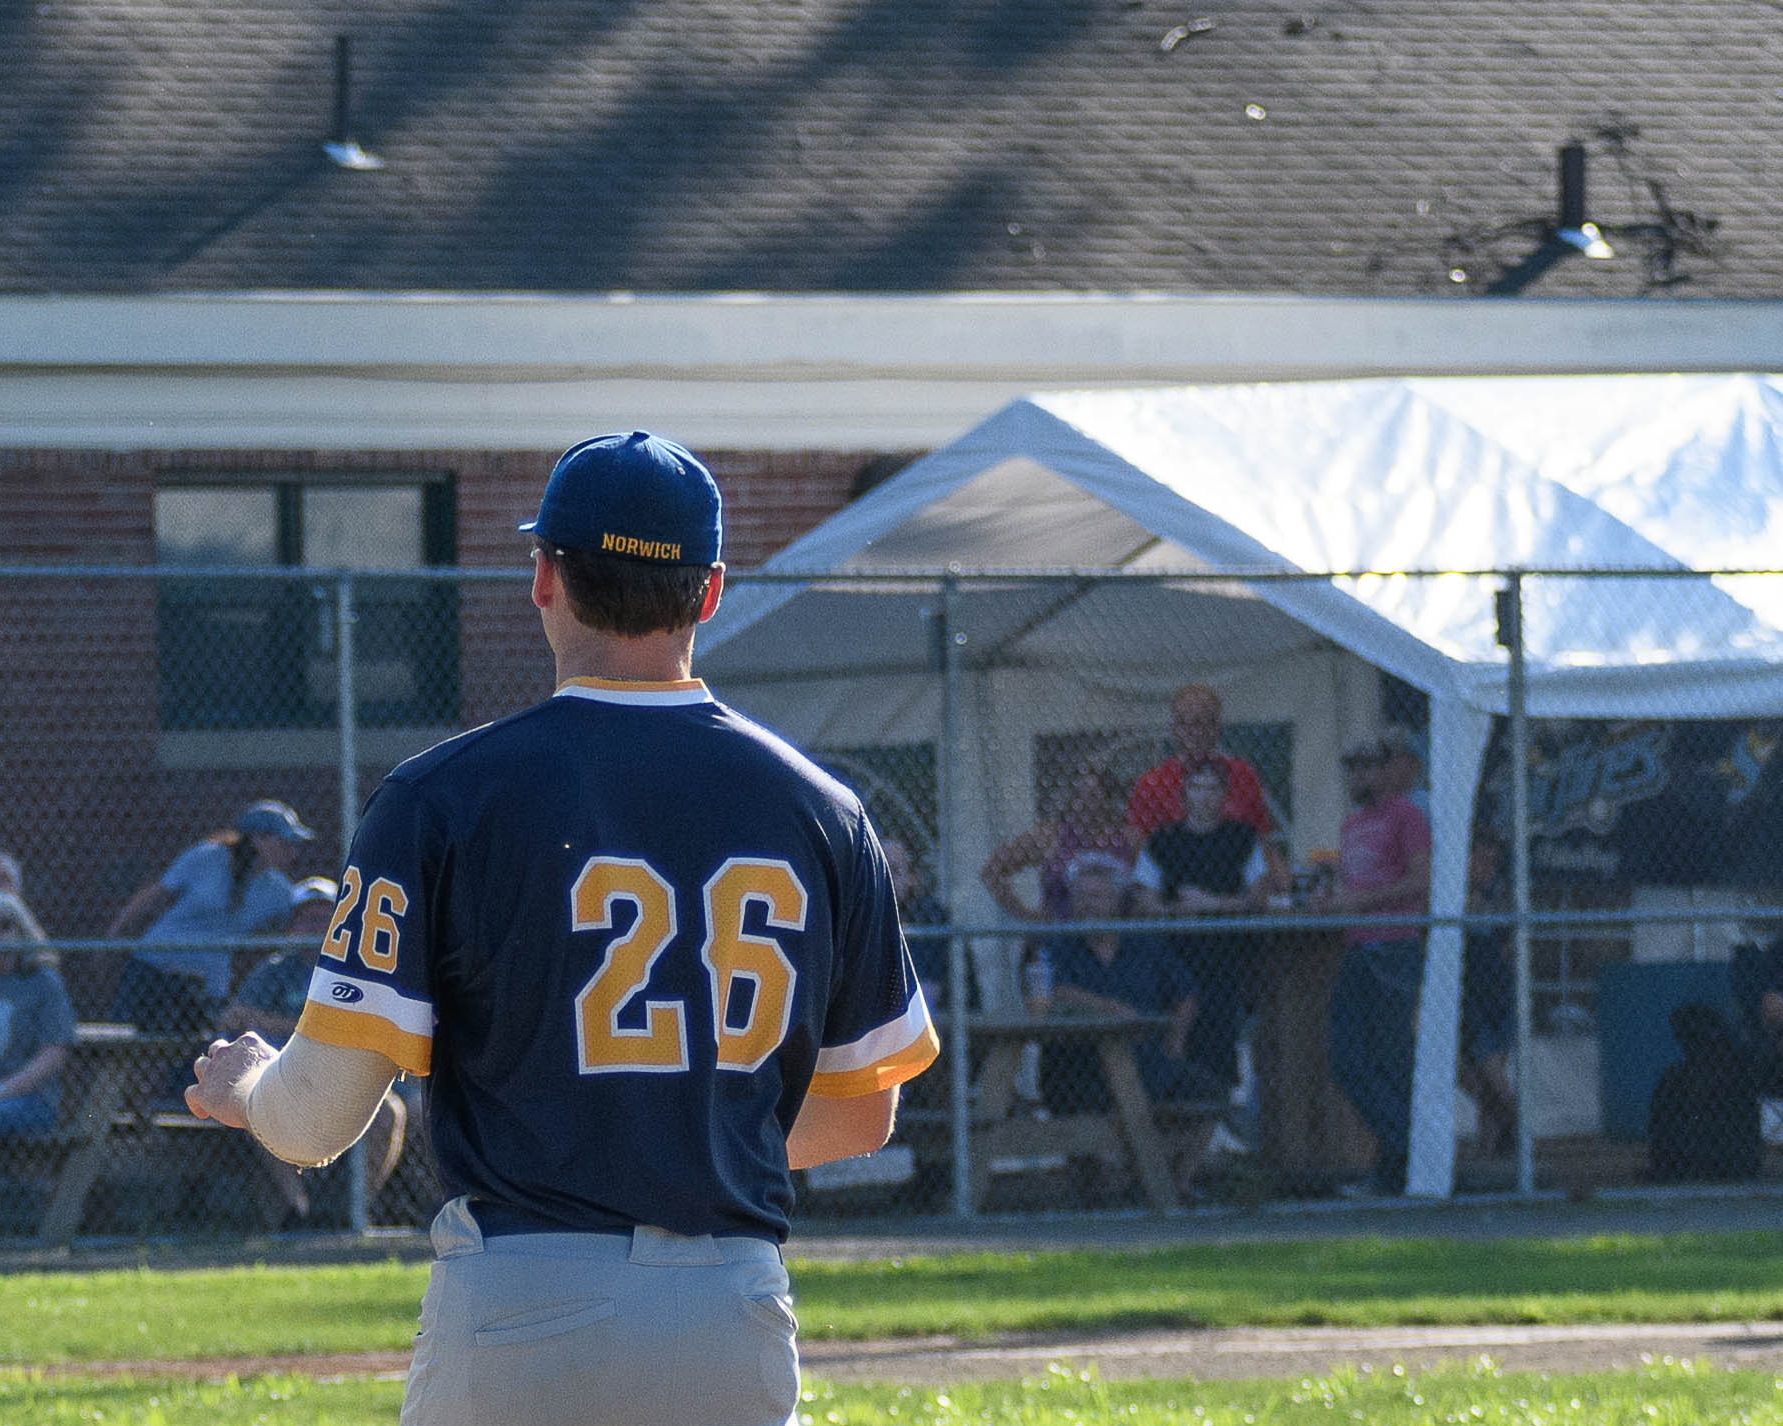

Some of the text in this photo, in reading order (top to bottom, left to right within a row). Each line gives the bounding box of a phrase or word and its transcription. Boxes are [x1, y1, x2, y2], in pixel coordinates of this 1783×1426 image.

[601, 532, 681, 560] NORWICH
[321, 865, 409, 974] 26
[570, 856, 808, 1075] 26
